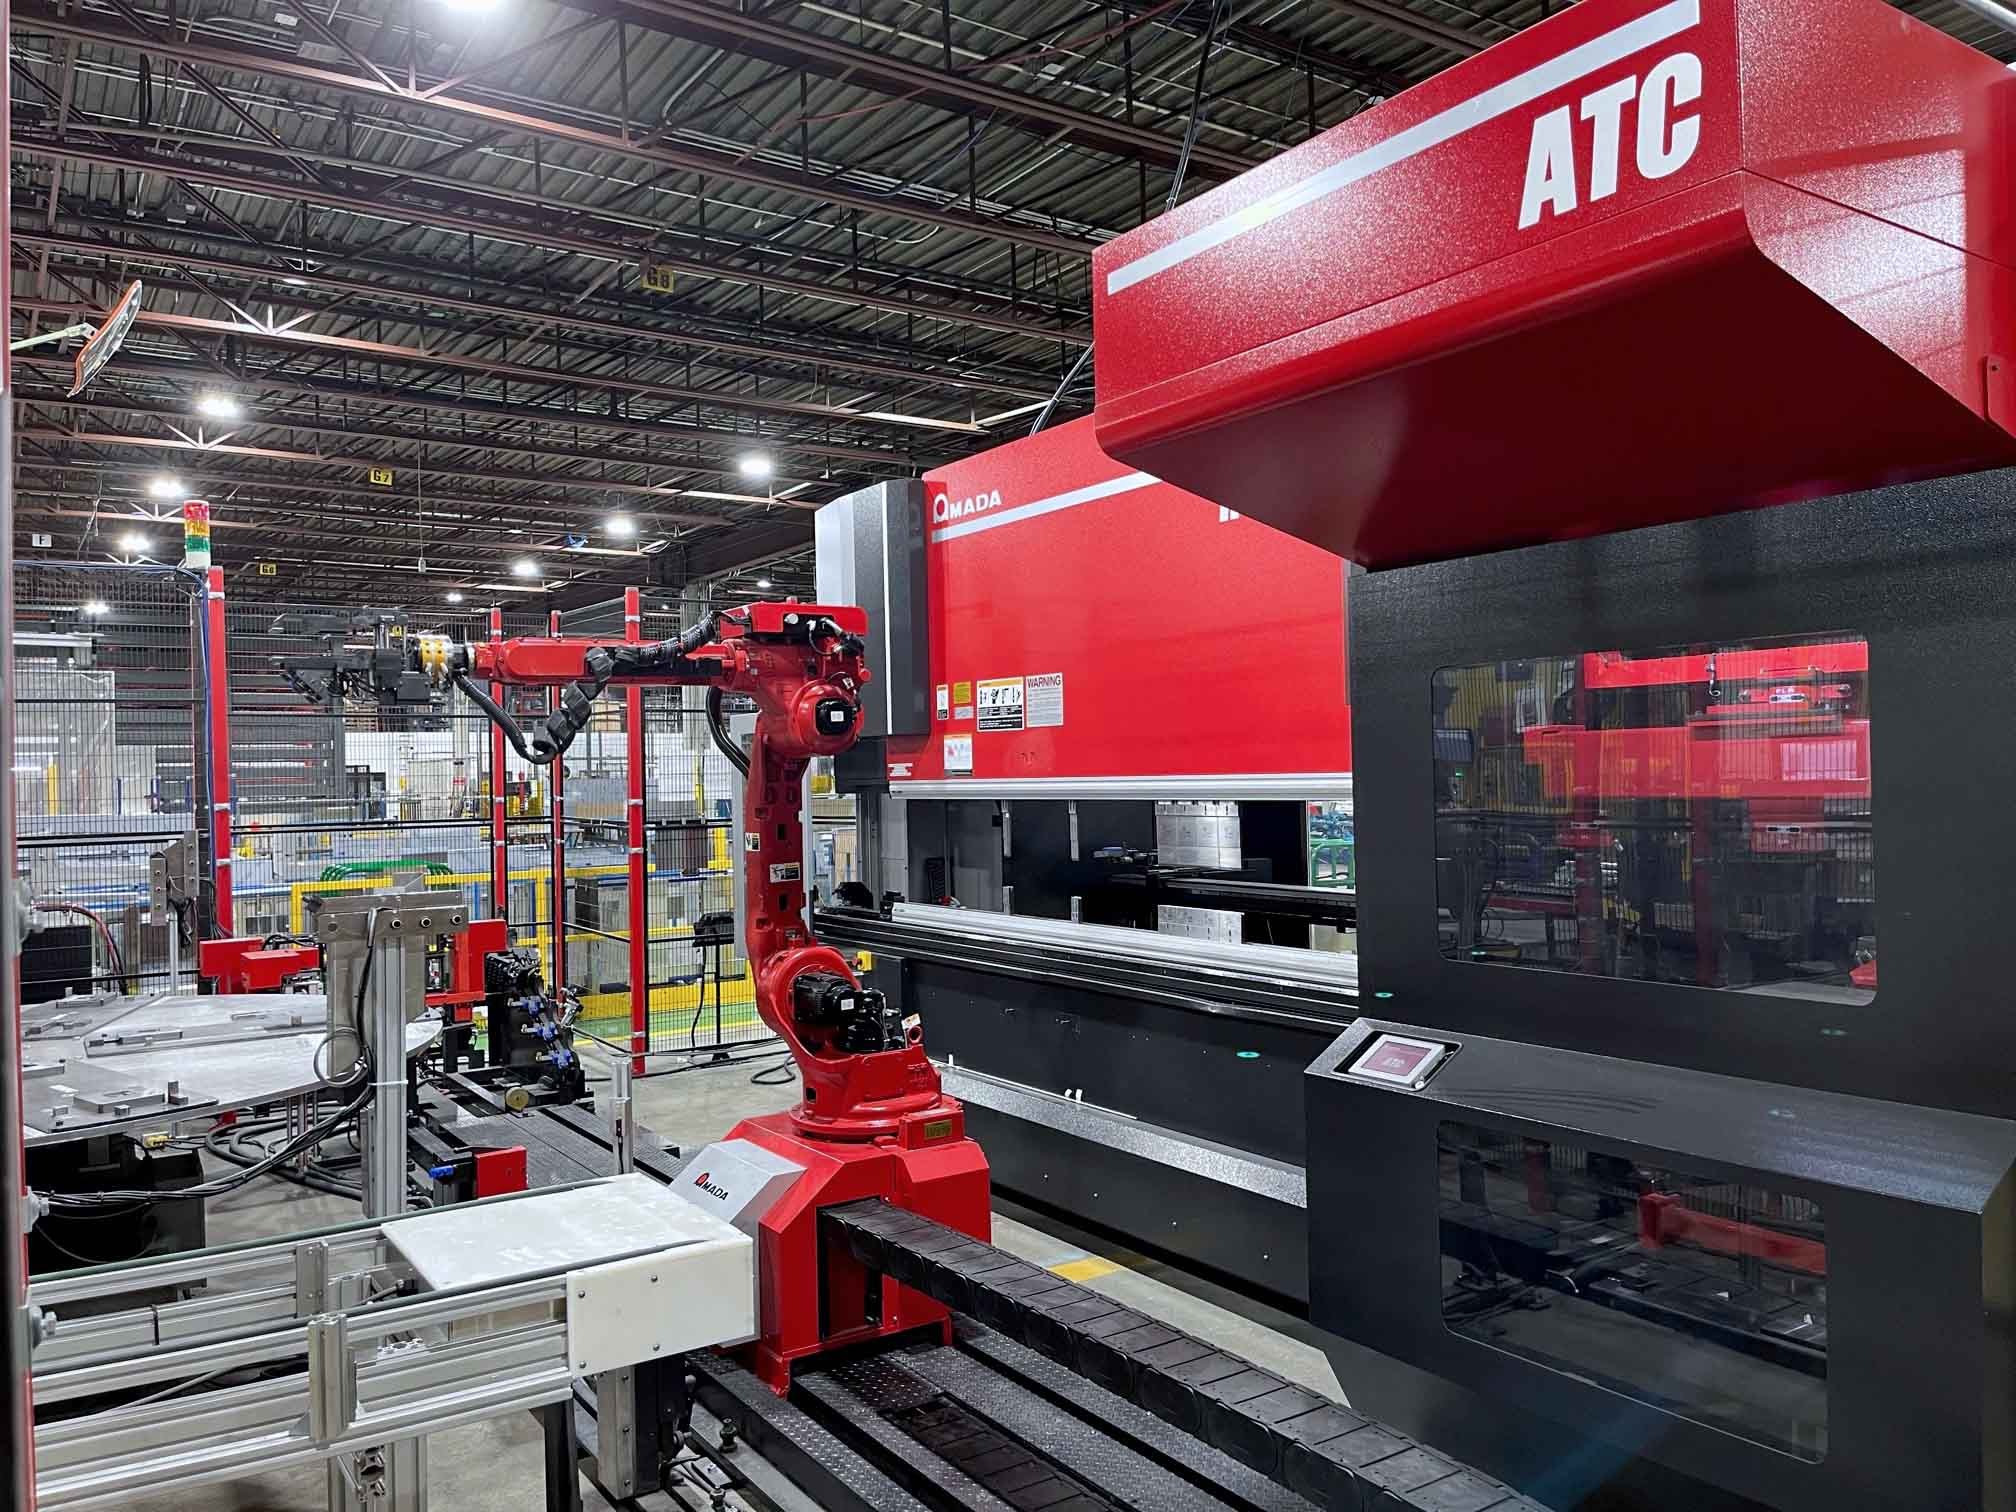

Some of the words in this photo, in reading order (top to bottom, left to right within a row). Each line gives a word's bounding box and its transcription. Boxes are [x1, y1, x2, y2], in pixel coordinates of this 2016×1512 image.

[1518, 52, 1702, 231] ATC
[374, 470, 389, 482] G7
[1027, 675, 1061, 688] WARNING
[693, 1172, 729, 1201] AMADA
